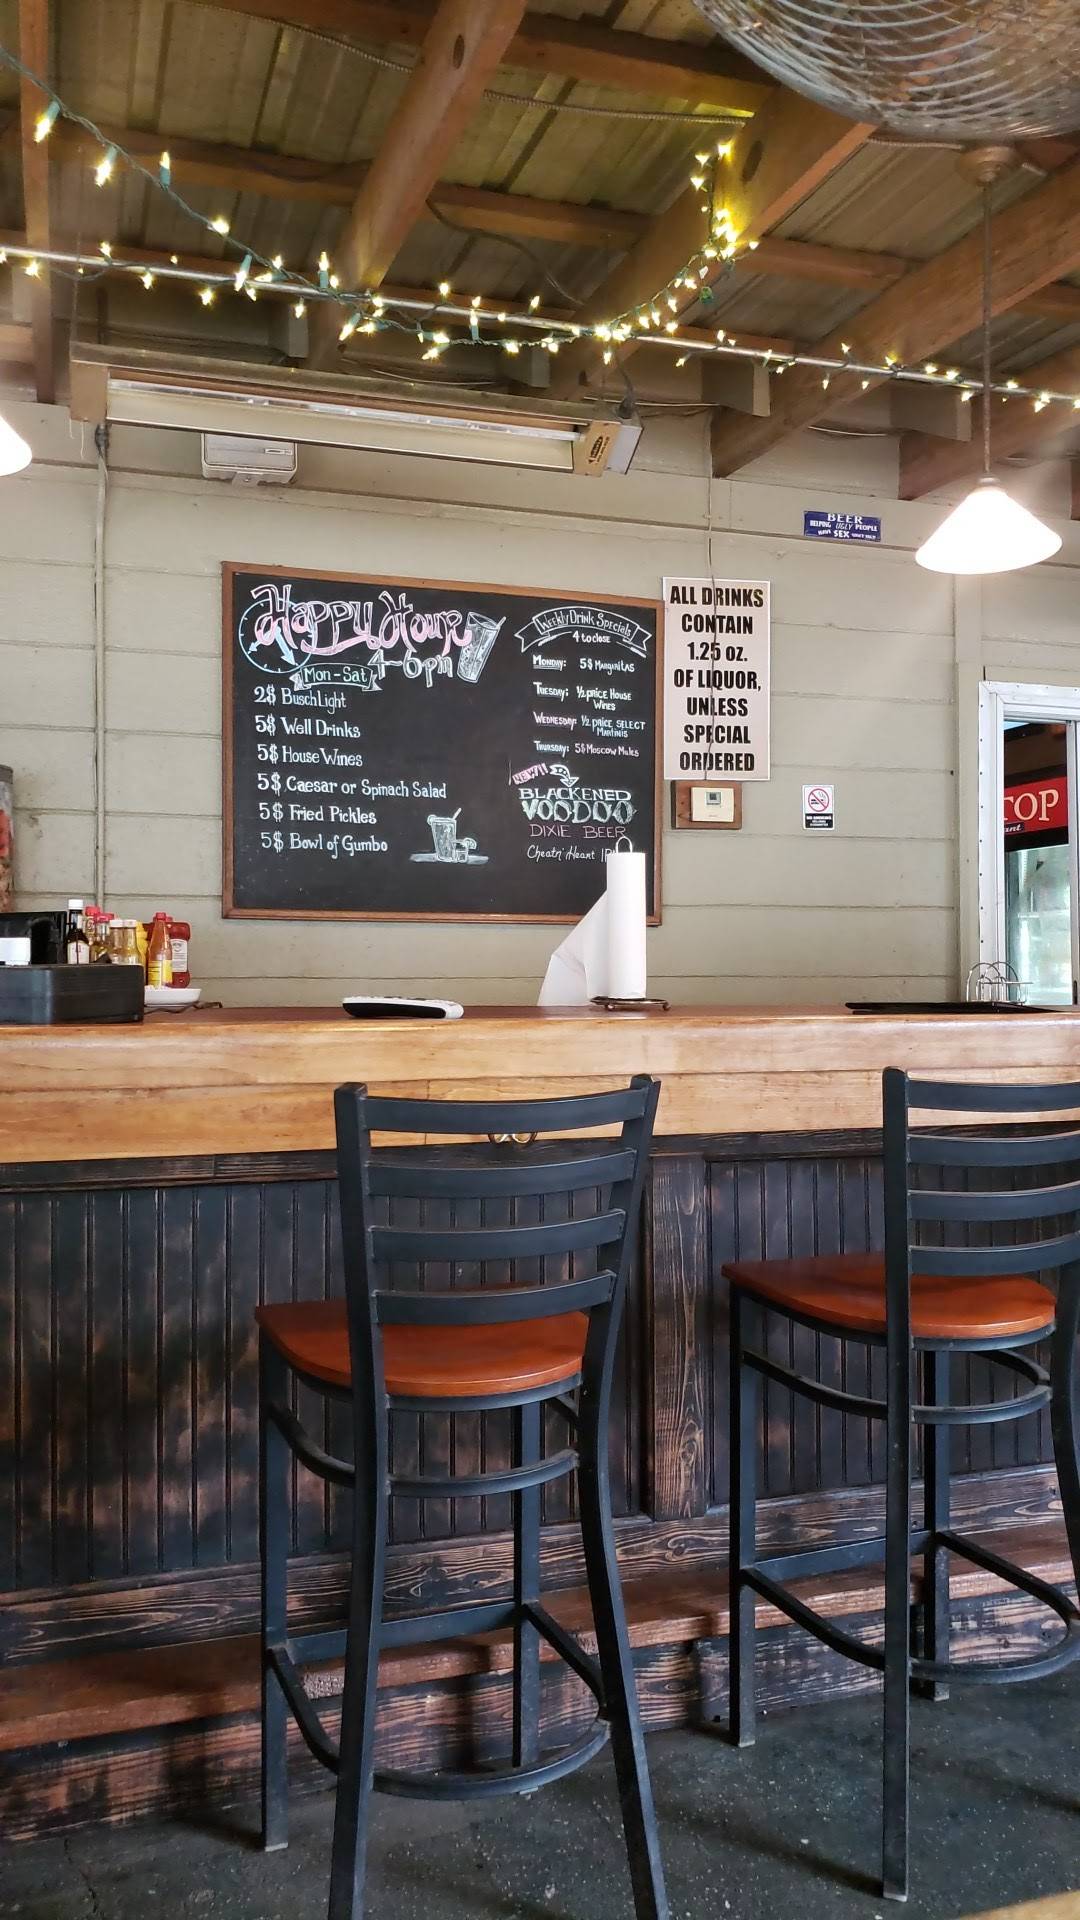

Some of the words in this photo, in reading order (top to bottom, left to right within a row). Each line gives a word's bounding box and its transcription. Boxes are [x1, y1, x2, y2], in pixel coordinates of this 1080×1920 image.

[827, 513, 863, 525] BEER
[833, 529, 850, 538] SEX
[669, 585, 698, 605] ALL
[701, 587, 764, 608] DRINKS
[251, 584, 382, 656] Happy
[378, 591, 473, 656] Hour
[681, 613, 754, 635] CONTAIN
[572, 630, 580, 643] 4
[581, 632, 592, 643] to
[687, 641, 721, 662] 1.25
[579, 657, 593, 671] 5$
[673, 668, 694, 688] OF
[697, 669, 762, 692] LIQUOR,
[254, 684, 276, 706] 2$
[686, 696, 749, 717] UNLESS
[254, 714, 276, 737] 5$
[280, 717, 312, 736] Well
[315, 719, 361, 738] Drinks
[616, 719, 646, 731] SELECT
[683, 724, 751, 745] SPECIAL
[257, 743, 279, 764] 5$
[282, 745, 320, 763] House
[319, 748, 363, 767] Wines
[574, 743, 586, 755] 5$
[679, 751, 755, 772] ORDERED
[257, 772, 282, 796] 5$
[286, 775, 338, 793] Caesar
[341, 783, 357, 795] or
[361, 779, 409, 800] Spinach
[412, 781, 447, 799] Salad
[518, 787, 632, 801] BLACKENED
[259, 802, 284, 823] 5$
[289, 803, 324, 822] Fried
[330, 806, 377, 825] Pickles
[521, 799, 637, 824] VOODOO
[529, 823, 572, 838] DIXIE
[582, 825, 627, 840] BEER
[260, 831, 284, 853] 5$
[290, 833, 323, 850] Bowl
[327, 835, 340, 859] of
[342, 835, 388, 857] Gumbo
[566, 845, 596, 860] Heart
